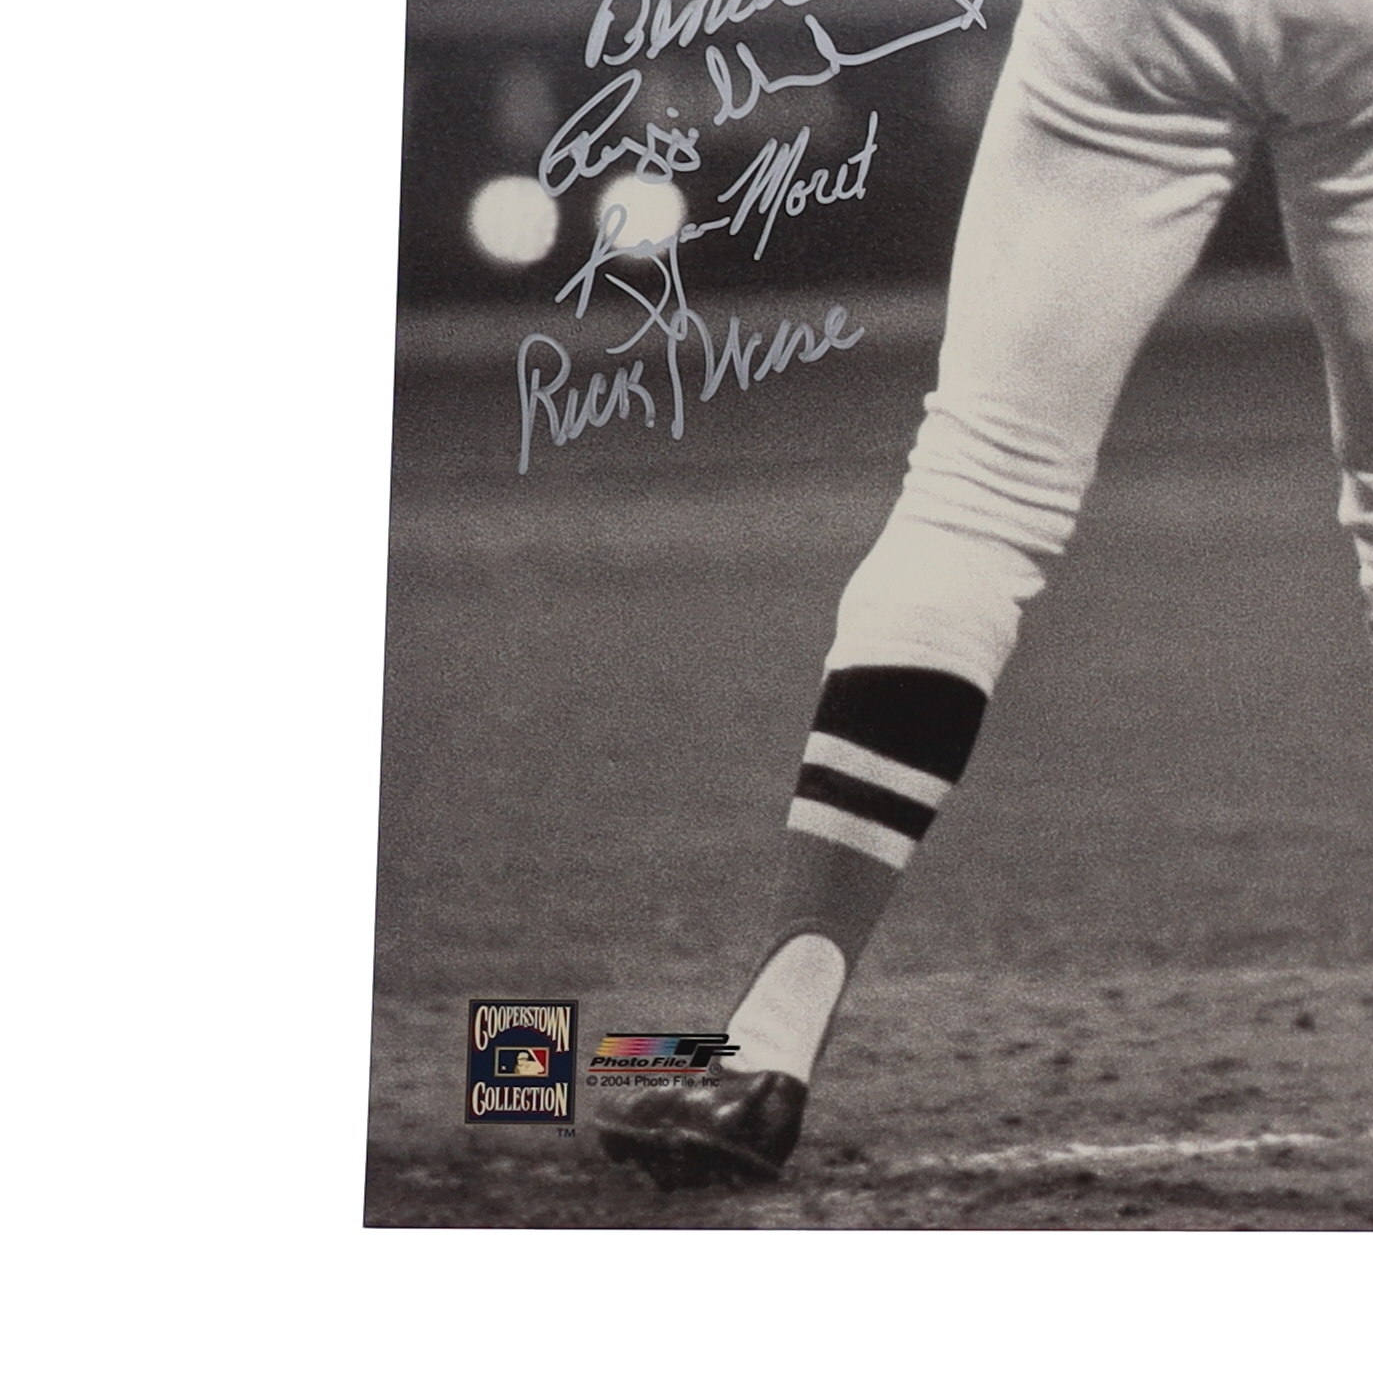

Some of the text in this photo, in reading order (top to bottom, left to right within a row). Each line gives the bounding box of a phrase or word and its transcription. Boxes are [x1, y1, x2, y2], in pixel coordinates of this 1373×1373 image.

[474, 1005, 572, 1053] COOPERSTOWN
[589, 1056, 688, 1068] Photo File
[601, 1076, 631, 1087] 2004
[634, 1076, 670, 1087] Photo
[472, 1082, 568, 1117] COLLECTION
